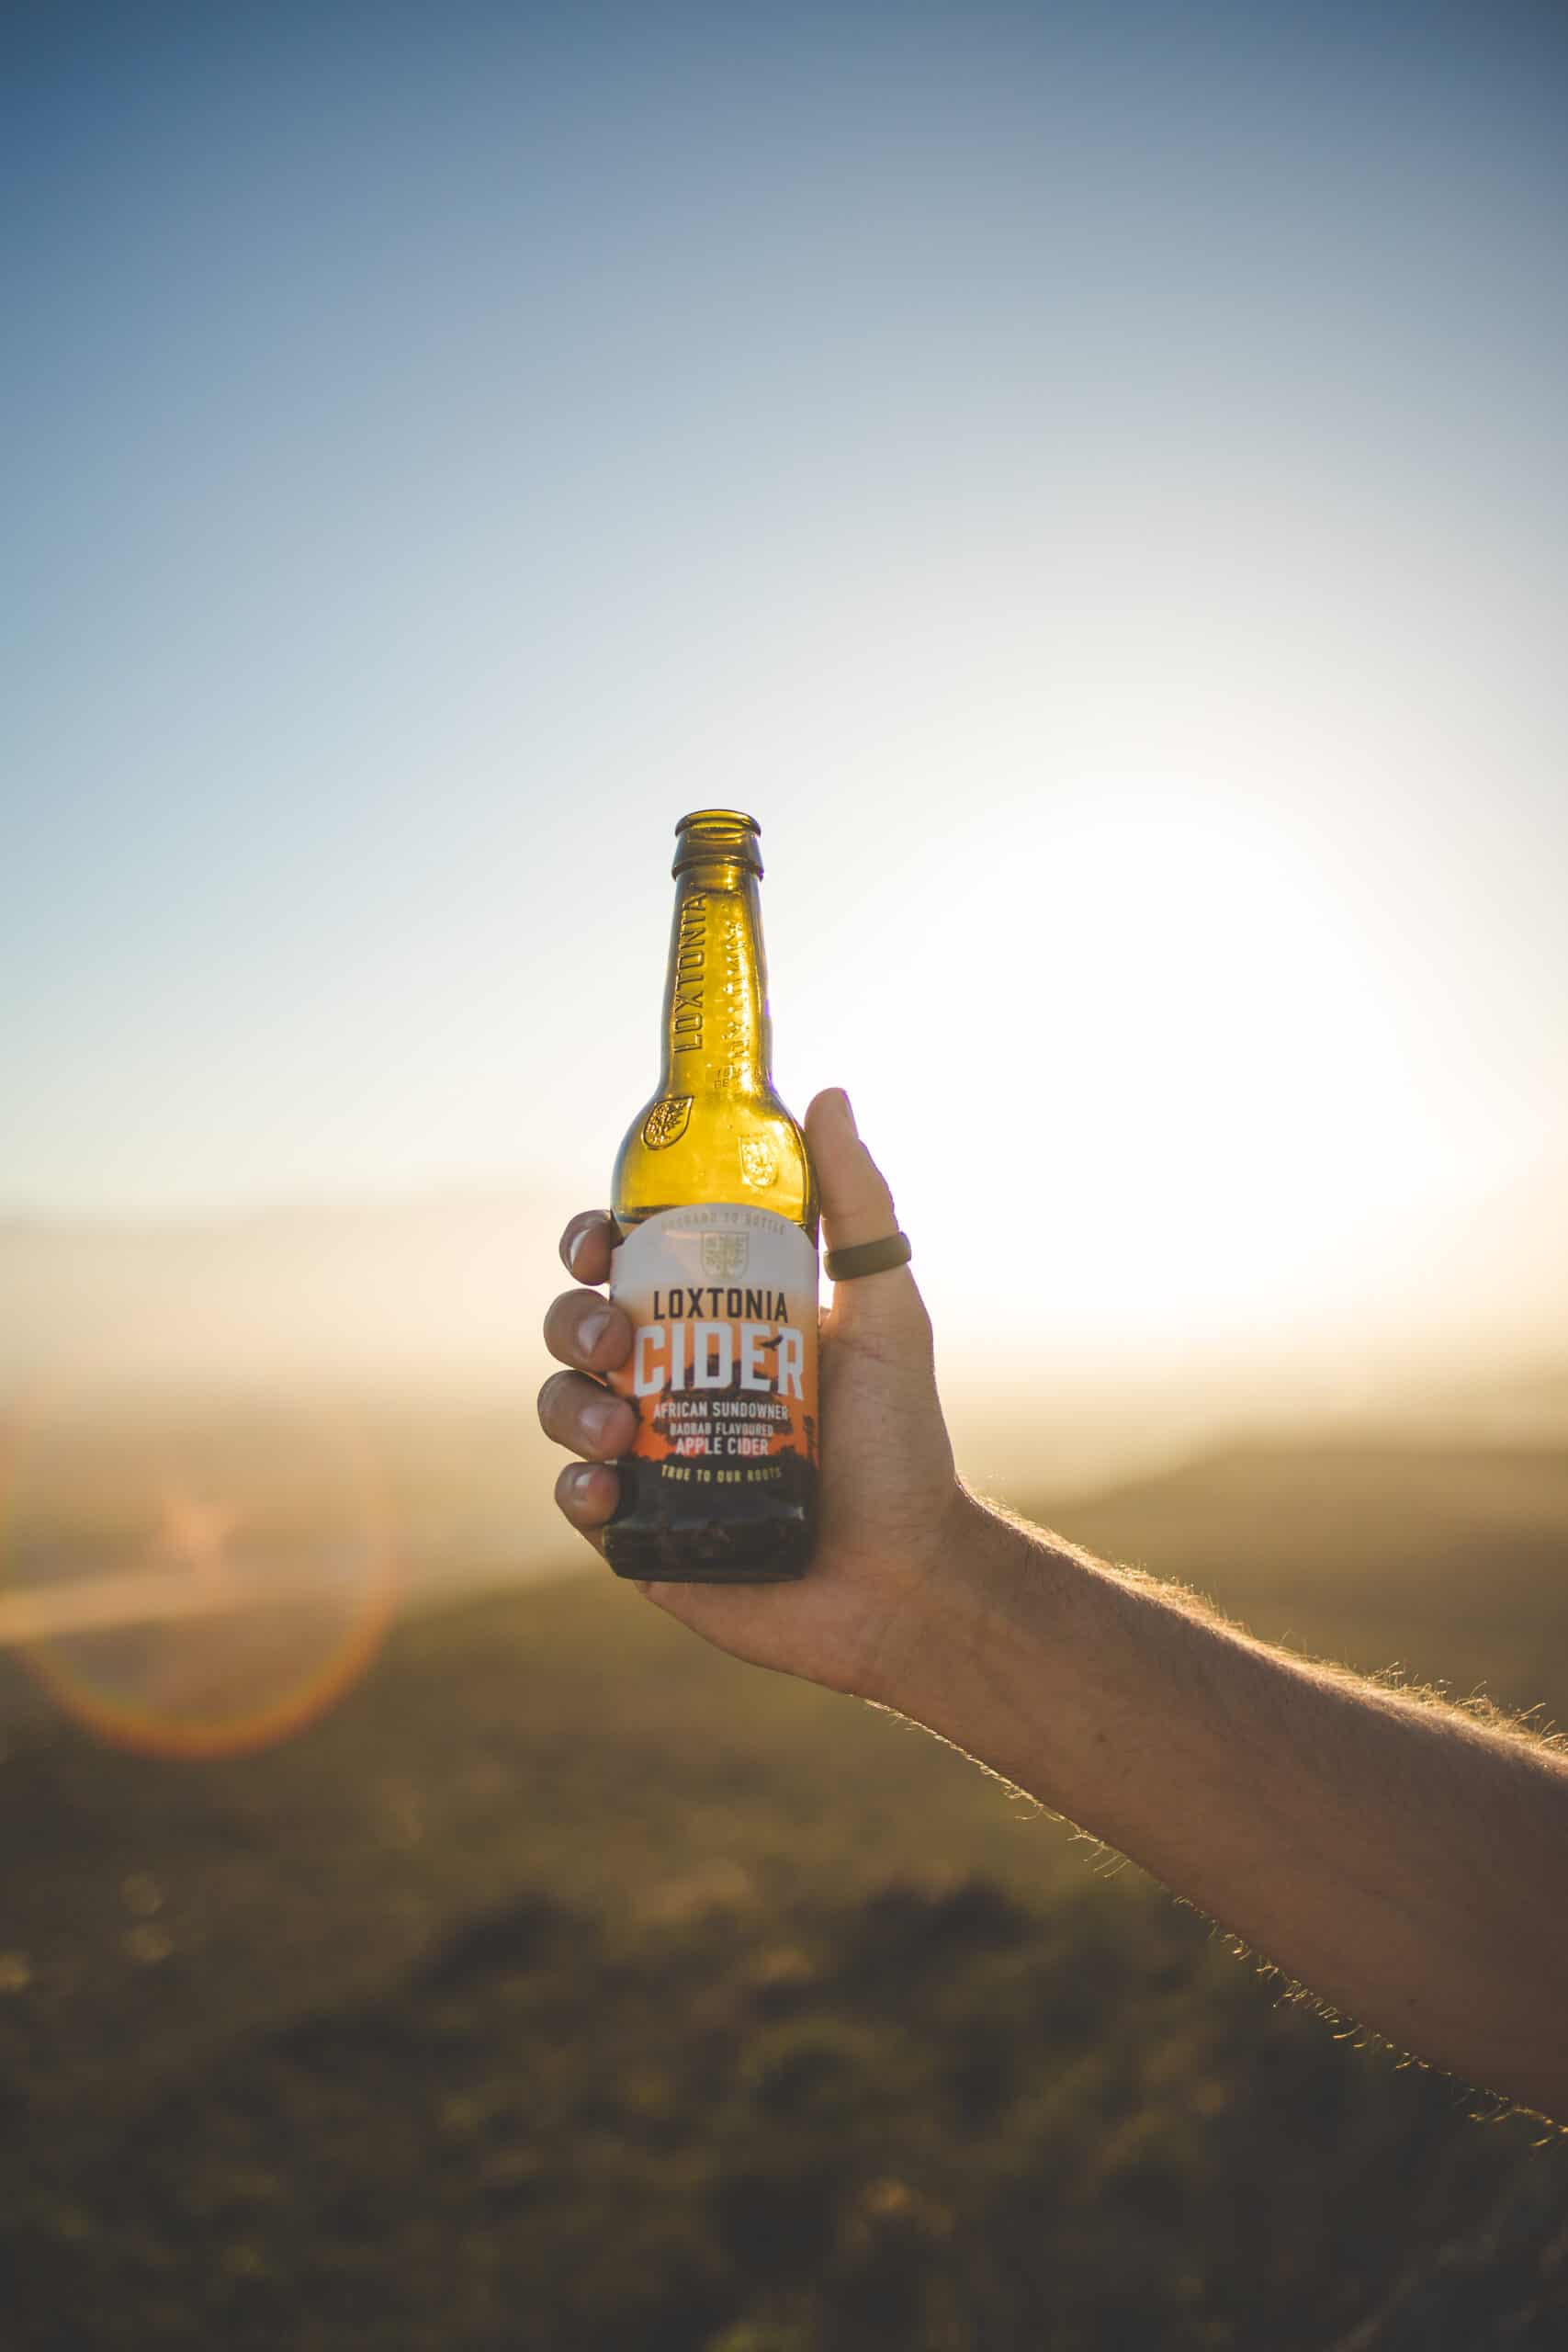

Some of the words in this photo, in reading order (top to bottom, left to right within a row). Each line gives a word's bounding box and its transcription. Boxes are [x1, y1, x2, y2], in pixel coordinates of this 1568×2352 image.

[673, 892, 707, 1054] LOXTONIA
[653, 1287, 789, 1324] LOXTONIA
[633, 1321, 805, 1401] CIDER
[653, 1401, 708, 1419] AFRICAN
[712, 1401, 789, 1421] SUNDOWNER
[715, 1423, 774, 1437] FLAVOURED
[675, 1436, 722, 1455] APPLE
[727, 1436, 769, 1456] CIDER
[661, 1464, 691, 1481] TRUE
[696, 1469, 711, 1483] TO
[716, 1469, 742, 1484] OUR
